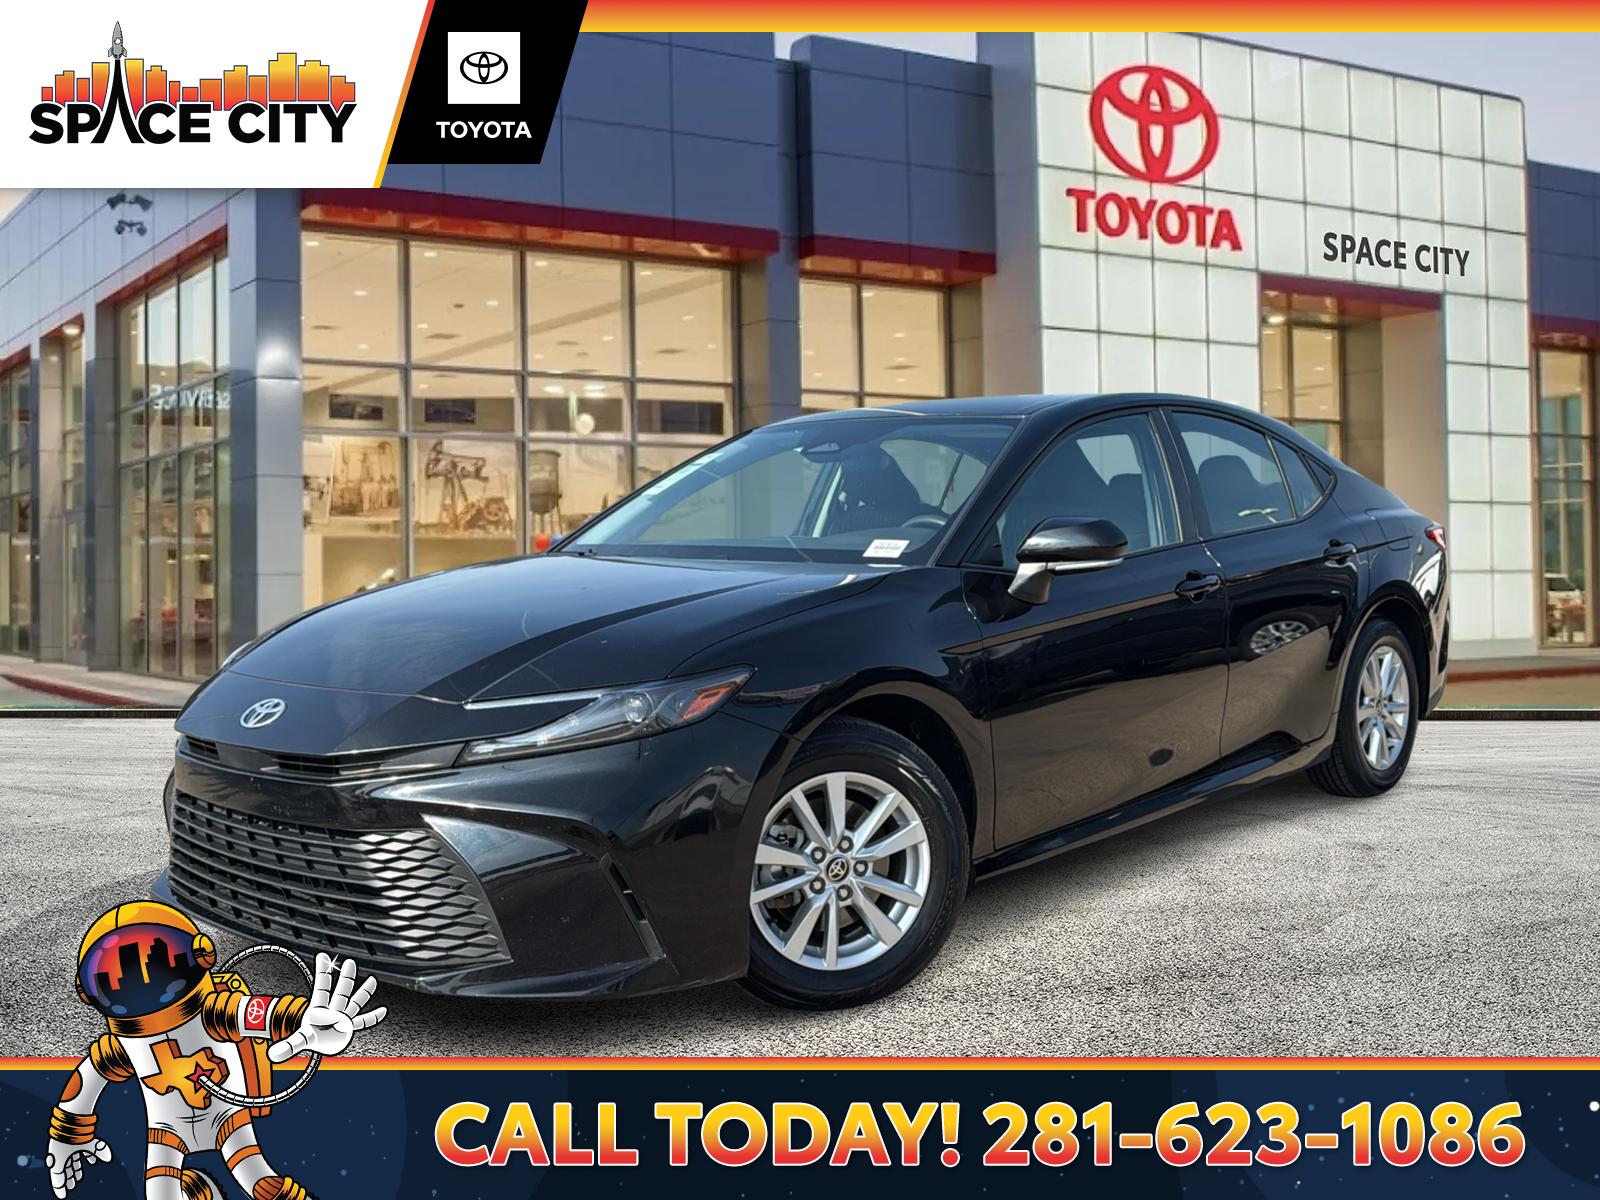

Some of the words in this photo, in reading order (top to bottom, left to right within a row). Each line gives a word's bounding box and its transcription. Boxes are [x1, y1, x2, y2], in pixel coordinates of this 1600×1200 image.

[1067, 188, 1243, 251] TOYOTA
[1323, 232, 1407, 270] SPACE
[1414, 244, 1470, 277] CITY
